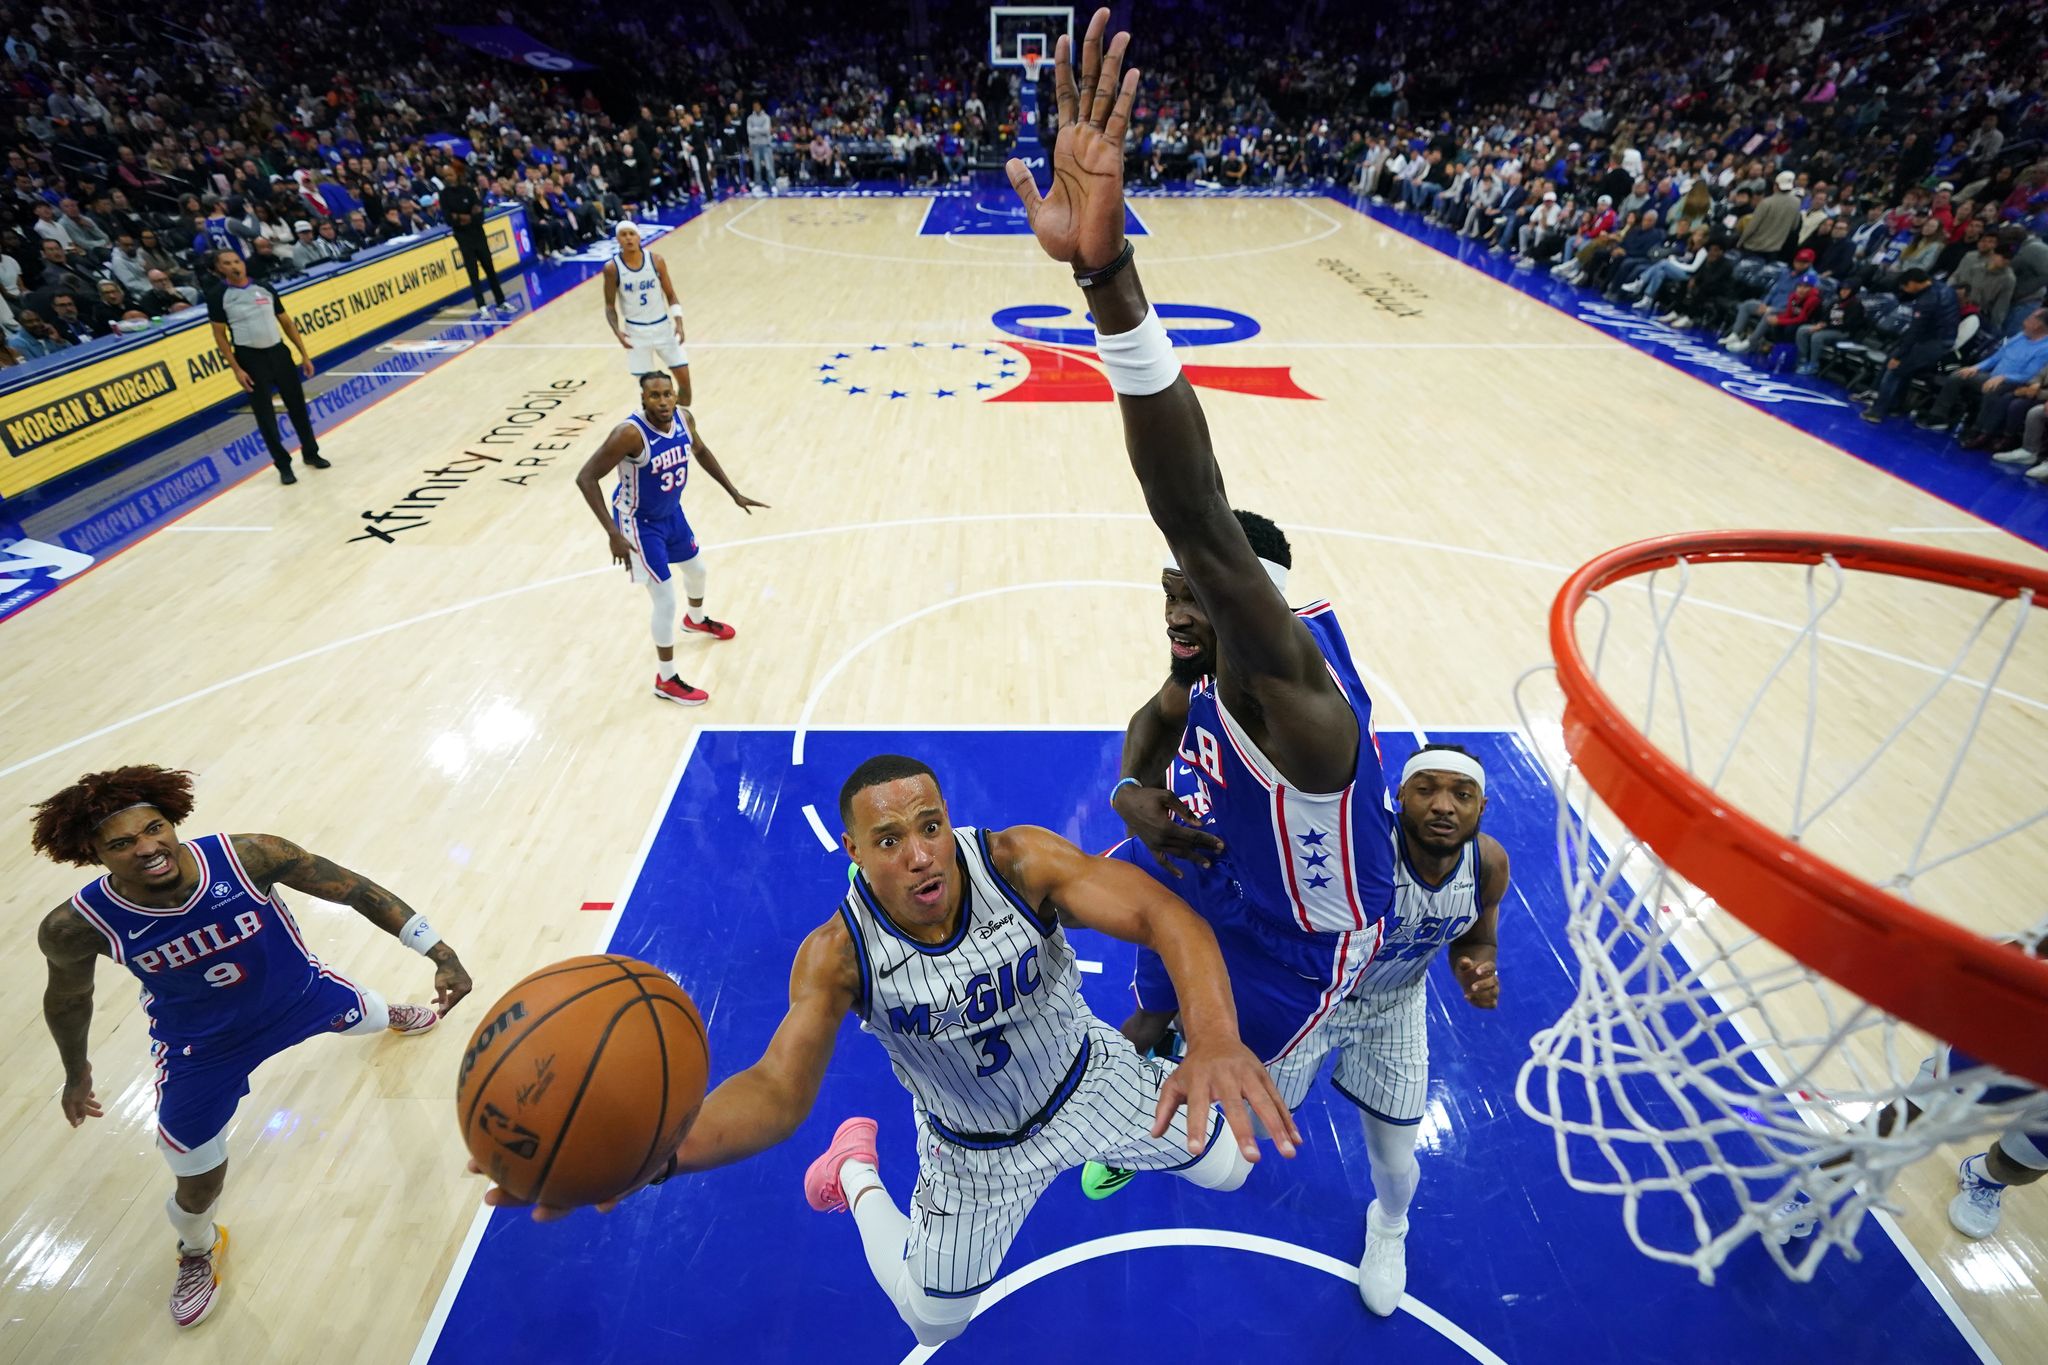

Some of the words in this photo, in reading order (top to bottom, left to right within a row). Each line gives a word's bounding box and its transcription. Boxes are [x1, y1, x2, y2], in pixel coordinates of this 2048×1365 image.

[624, 278, 656, 292] MGIC
[639, 293, 648, 306] 5
[6, 398, 90, 450] MORGAN
[86, 392, 106, 418] &
[100, 365, 169, 414] MORGAN
[293, 298, 348, 336] ARGEST
[348, 279, 394, 315] INJURY
[394, 271, 421, 295] LAW
[422, 259, 446, 286] FIRM
[345, 450, 503, 544] xfinity
[476, 378, 587, 444] mobile
[499, 412, 604, 486] ARENA
[660, 466, 687, 492] 33
[210, 891, 246, 911] crypto.com
[973, 913, 1015, 940] Disney
[131, 910, 264, 973] PHILA
[203, 962, 247, 988] 9
[971, 1024, 1013, 1078] 3
